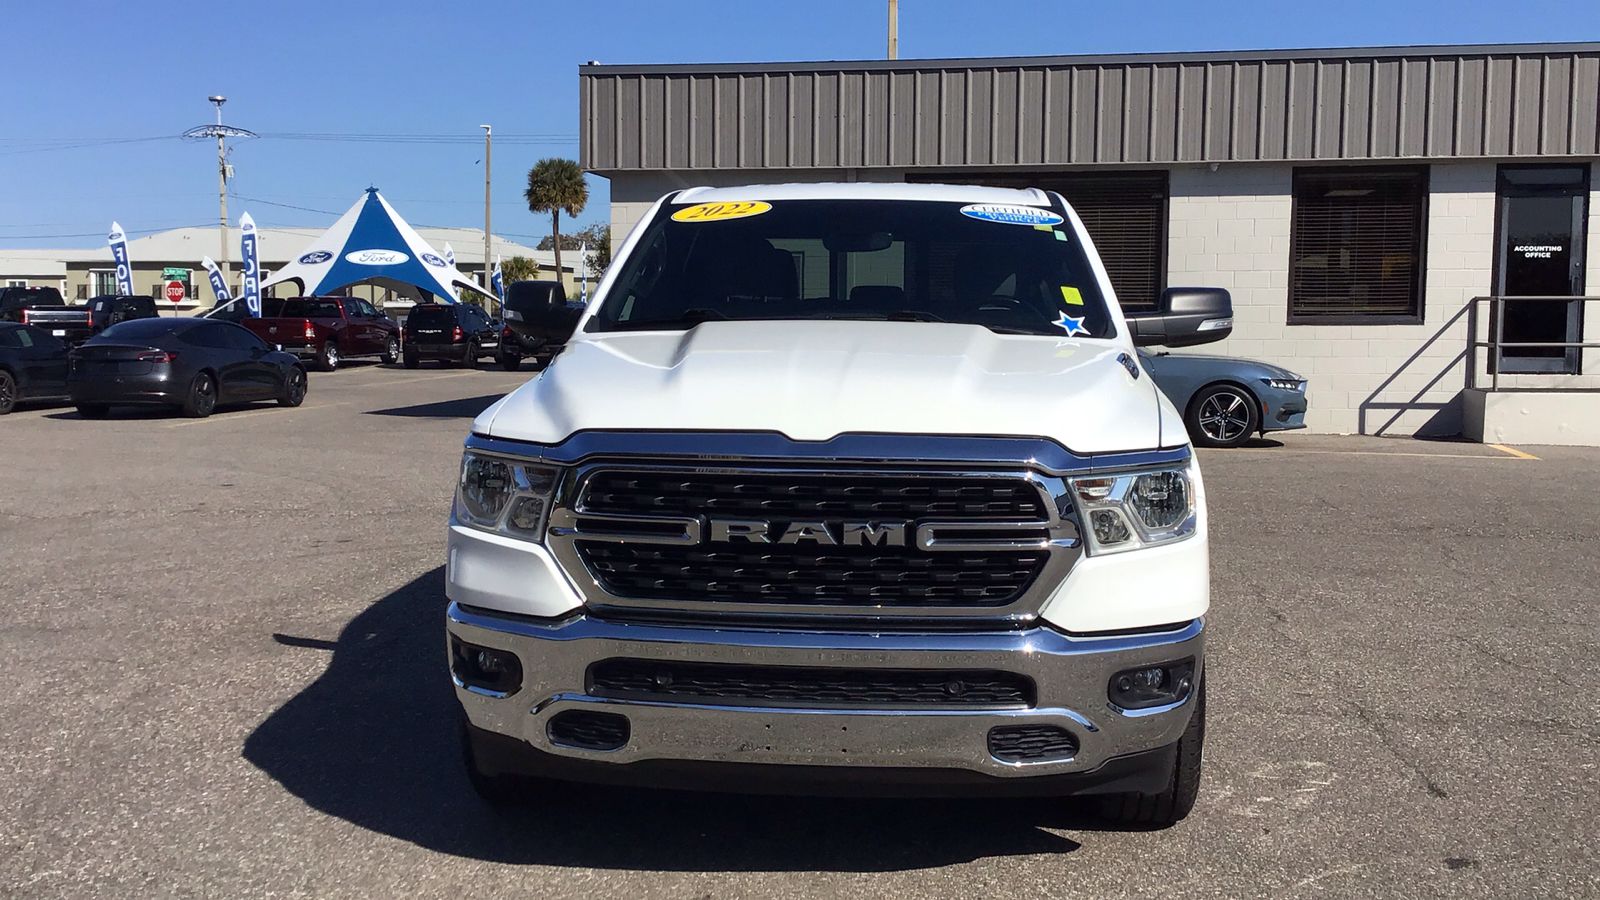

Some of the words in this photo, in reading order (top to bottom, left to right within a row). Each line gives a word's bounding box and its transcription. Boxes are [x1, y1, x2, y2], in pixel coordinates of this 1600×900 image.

[686, 202, 756, 219] 2022
[971, 205, 1050, 217] CERTIFIED
[302, 252, 330, 263] Ford
[358, 252, 396, 263] Ford
[167, 287, 184, 297] STOP
[710, 519, 906, 546] RAM
